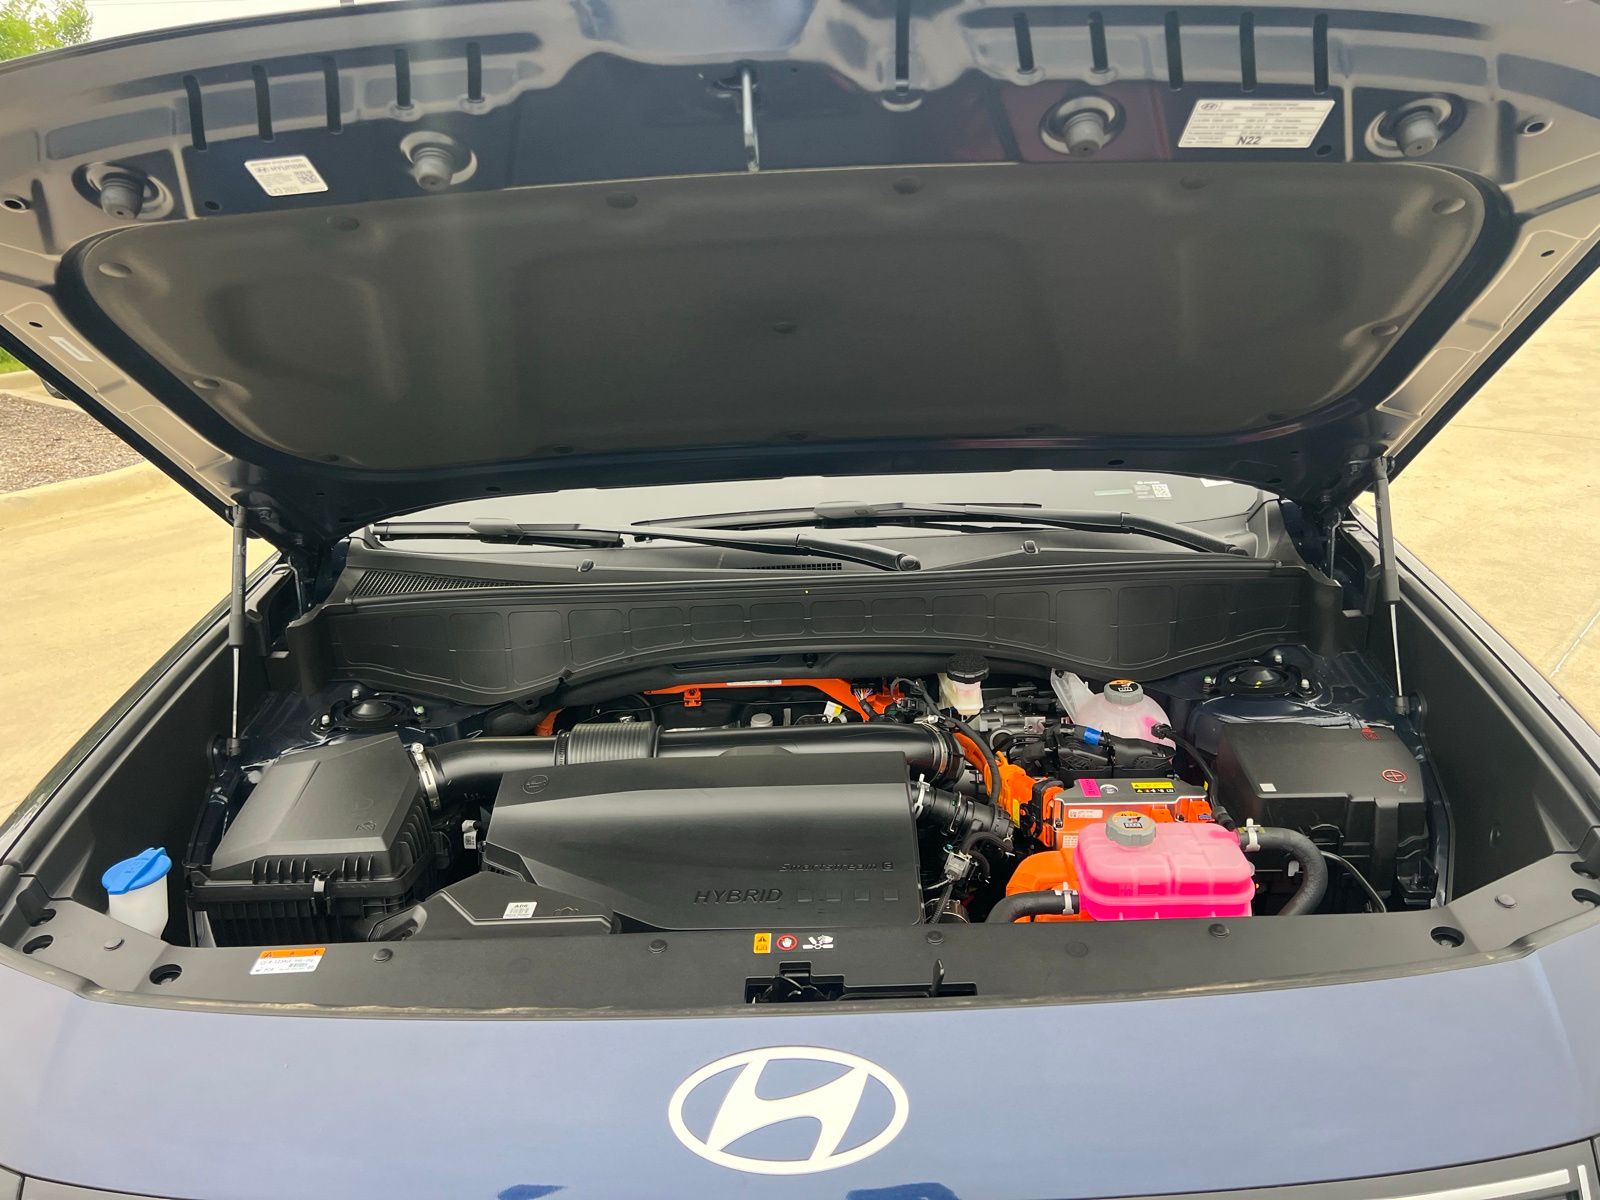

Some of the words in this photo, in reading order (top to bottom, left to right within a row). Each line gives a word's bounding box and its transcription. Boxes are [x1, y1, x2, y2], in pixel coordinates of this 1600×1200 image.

[1235, 136, 1262, 145] N22
[778, 862, 878, 872] Smartstream
[693, 888, 784, 905] HYBRID
